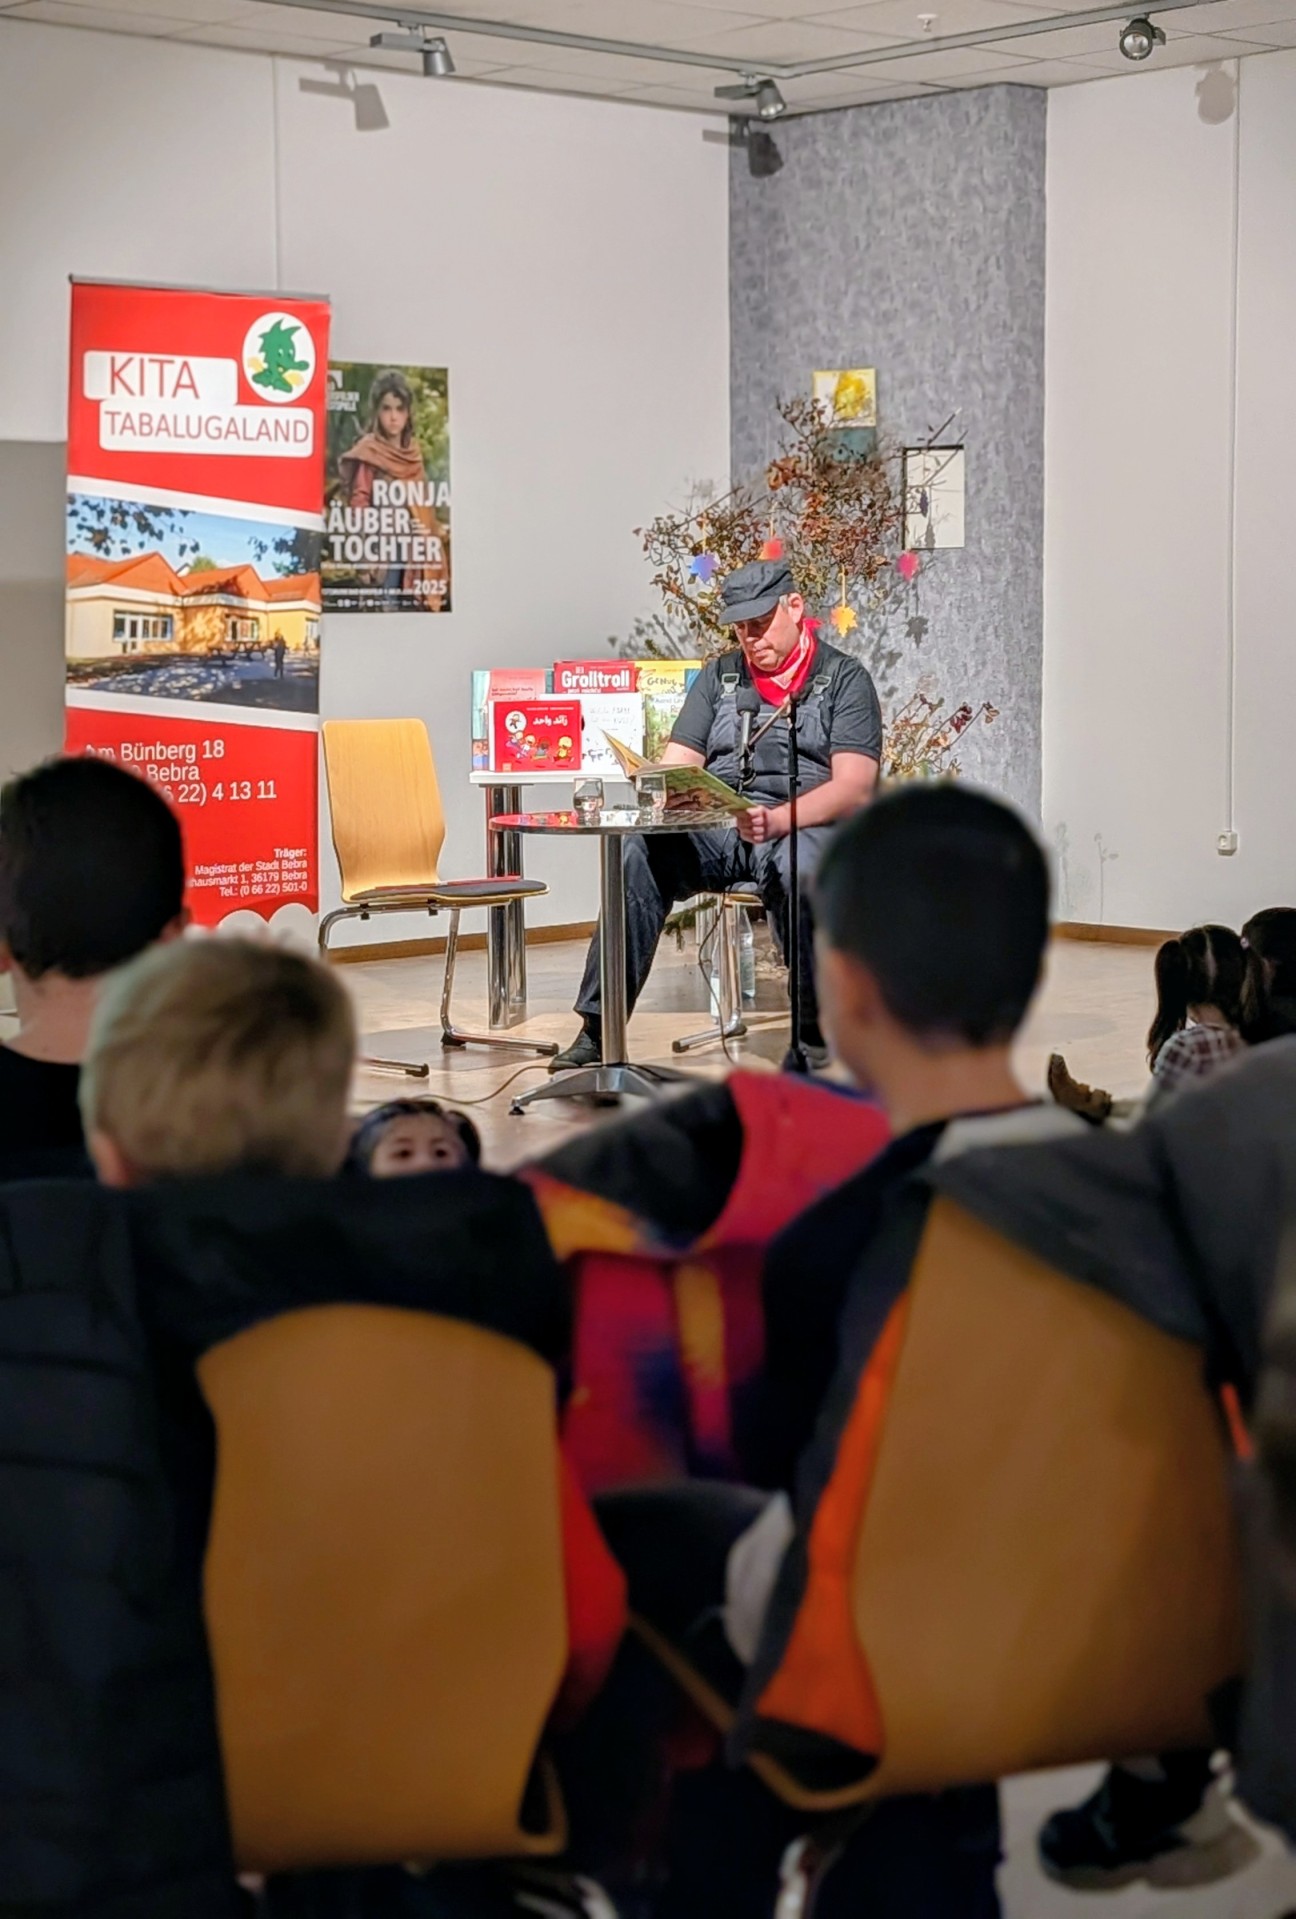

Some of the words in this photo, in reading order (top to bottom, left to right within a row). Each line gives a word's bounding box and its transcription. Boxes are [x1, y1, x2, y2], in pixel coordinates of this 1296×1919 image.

[109, 356, 199, 399] KITA
[104, 411, 310, 444] TABALUGALAND
[372, 480, 451, 507] RONJA
[327, 499, 411, 534] ÄUBER
[329, 535, 442, 562] TOCHTER
[413, 579, 448, 595] 2025
[561, 669, 630, 688] Grolltroll
[121, 741, 196, 764] Bünberg
[202, 739, 225, 759] 18
[146, 762, 200, 782] Bebra
[178, 784, 207, 806] 22)
[212, 783, 224, 800] 4
[230, 782, 252, 800] 13
[257, 780, 277, 799] 11
[274, 848, 307, 859] Träger:
[194, 863, 237, 876] Magistrat
[239, 862, 253, 872] der
[255, 860, 280, 871] Stadt
[281, 859, 307, 869] Bebra
[251, 871, 280, 883] 36179
[281, 870, 307, 881] Bebra
[251, 884, 263, 895] 66
[265, 883, 280, 895] 22)
[282, 881, 307, 893] 501-0
